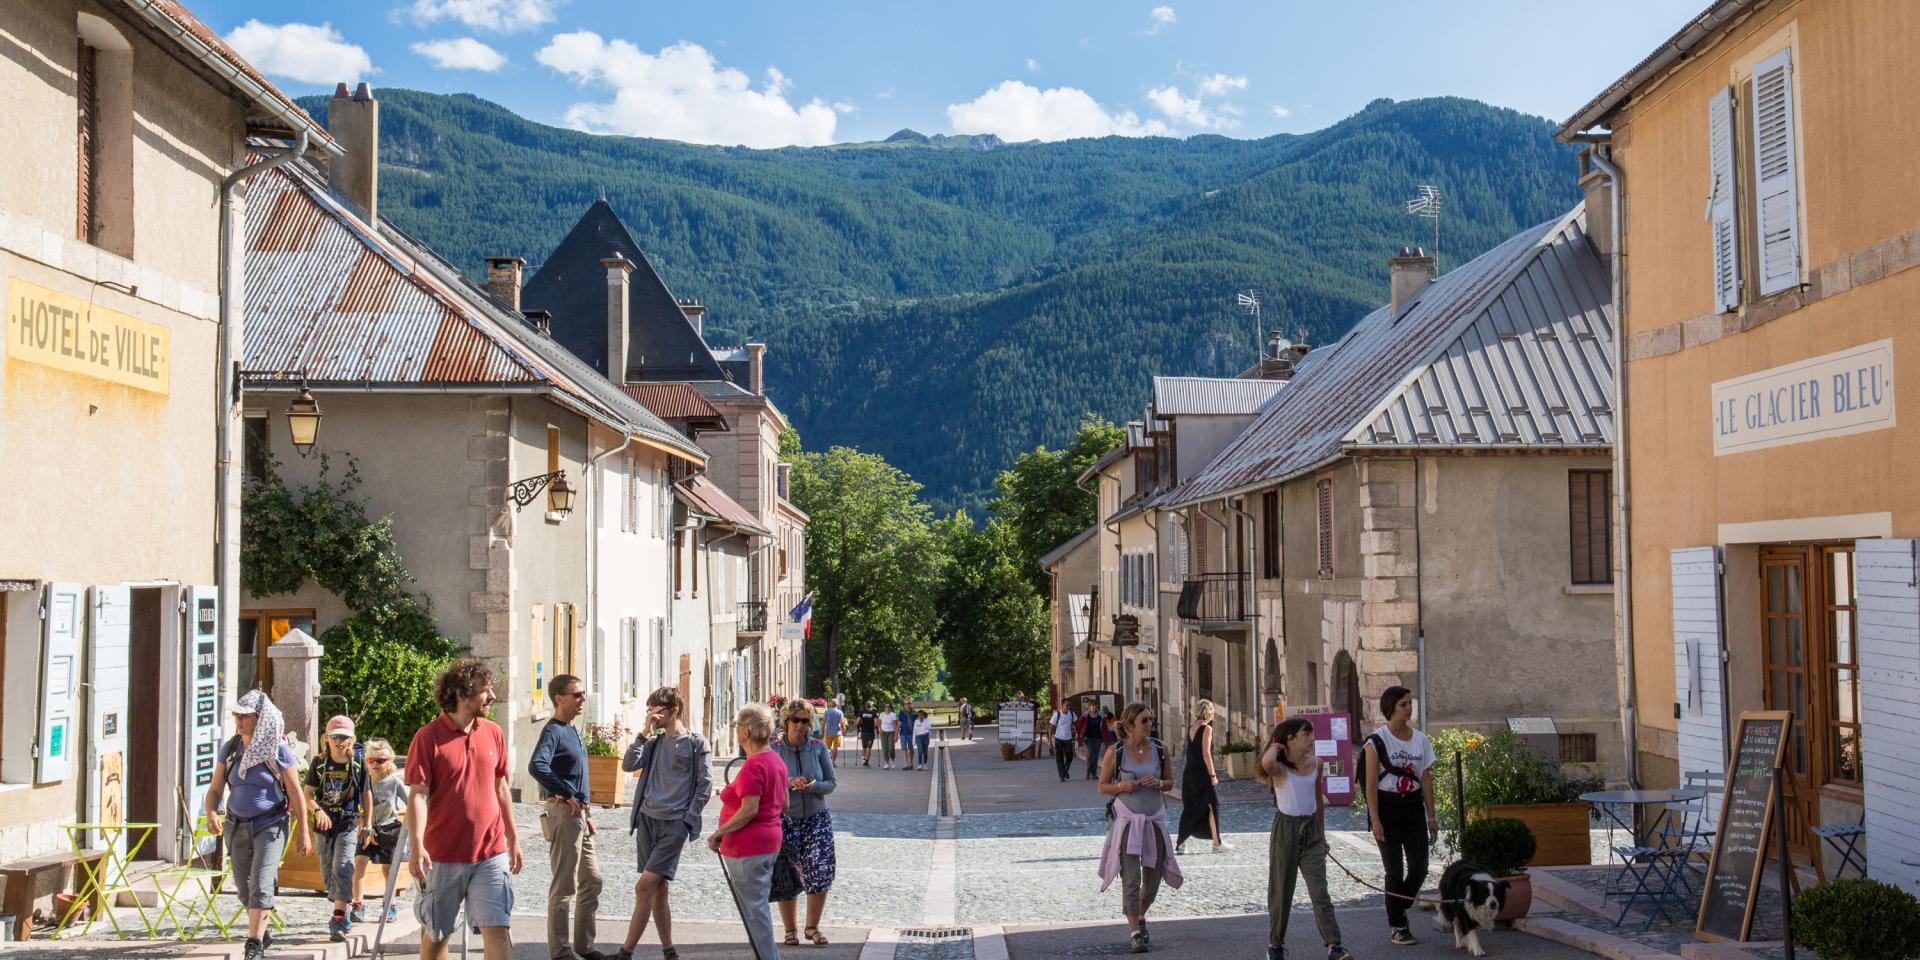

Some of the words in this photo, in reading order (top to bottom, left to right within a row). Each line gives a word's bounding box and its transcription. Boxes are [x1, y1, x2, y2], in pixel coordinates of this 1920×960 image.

[20, 297, 85, 360] HOTEL
[90, 330, 110, 367] DE
[115, 325, 160, 379] VILLE
[1719, 398, 1738, 436] LE
[1745, 379, 1821, 430] GLACIER
[1833, 364, 1883, 414] BLEU
